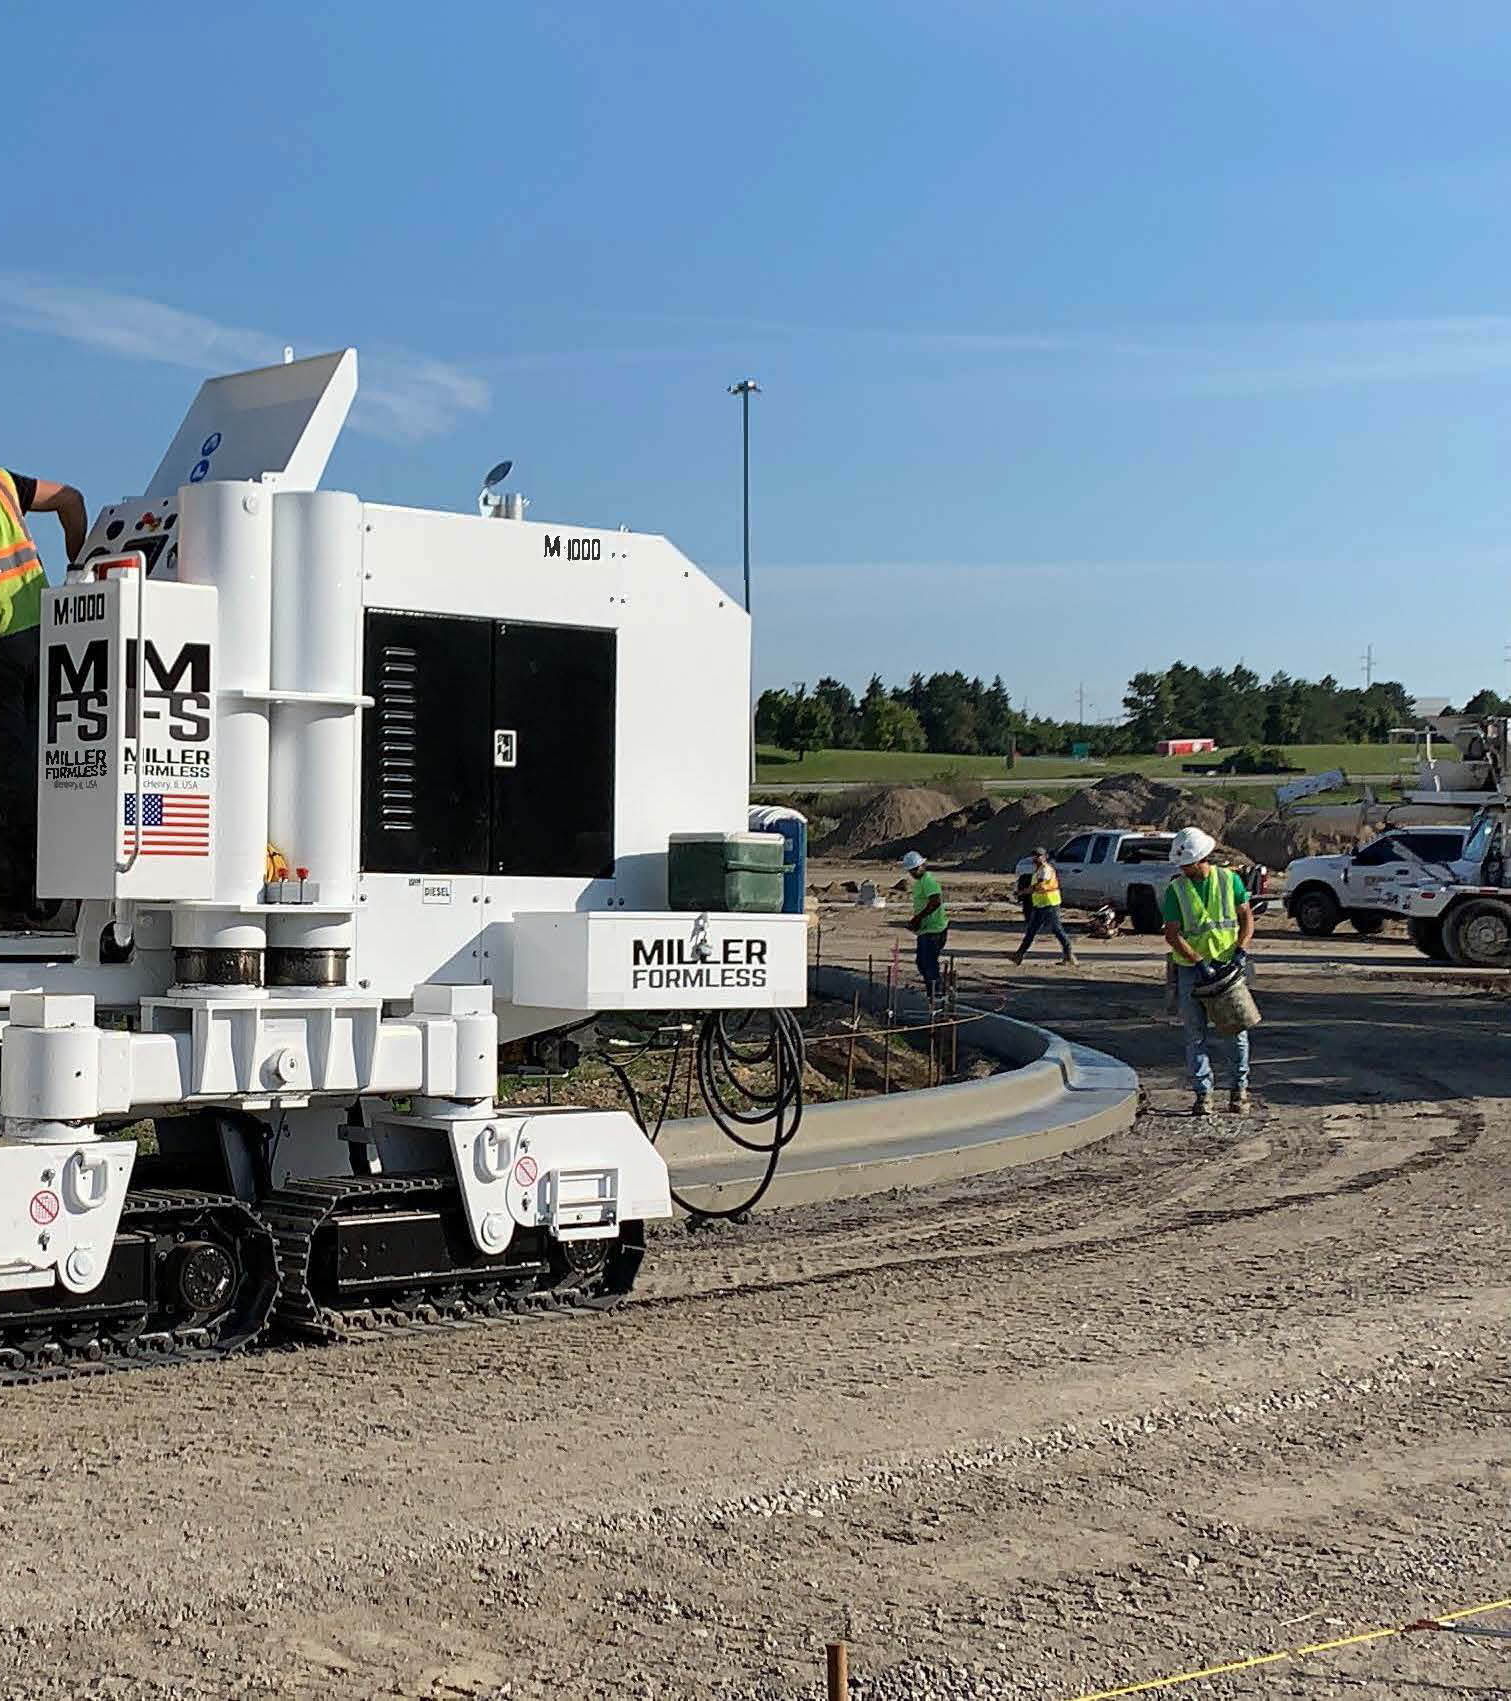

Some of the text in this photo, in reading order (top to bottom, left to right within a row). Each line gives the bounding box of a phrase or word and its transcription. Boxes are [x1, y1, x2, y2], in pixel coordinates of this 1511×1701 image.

[45, 749, 108, 766] MILLER
[45, 765, 108, 780] FORMLESS
[183, 780, 198, 790] USA
[424, 887, 450, 897] DIESEL
[632, 939, 768, 966] MILLER
[632, 968, 767, 989] FORMLESS
